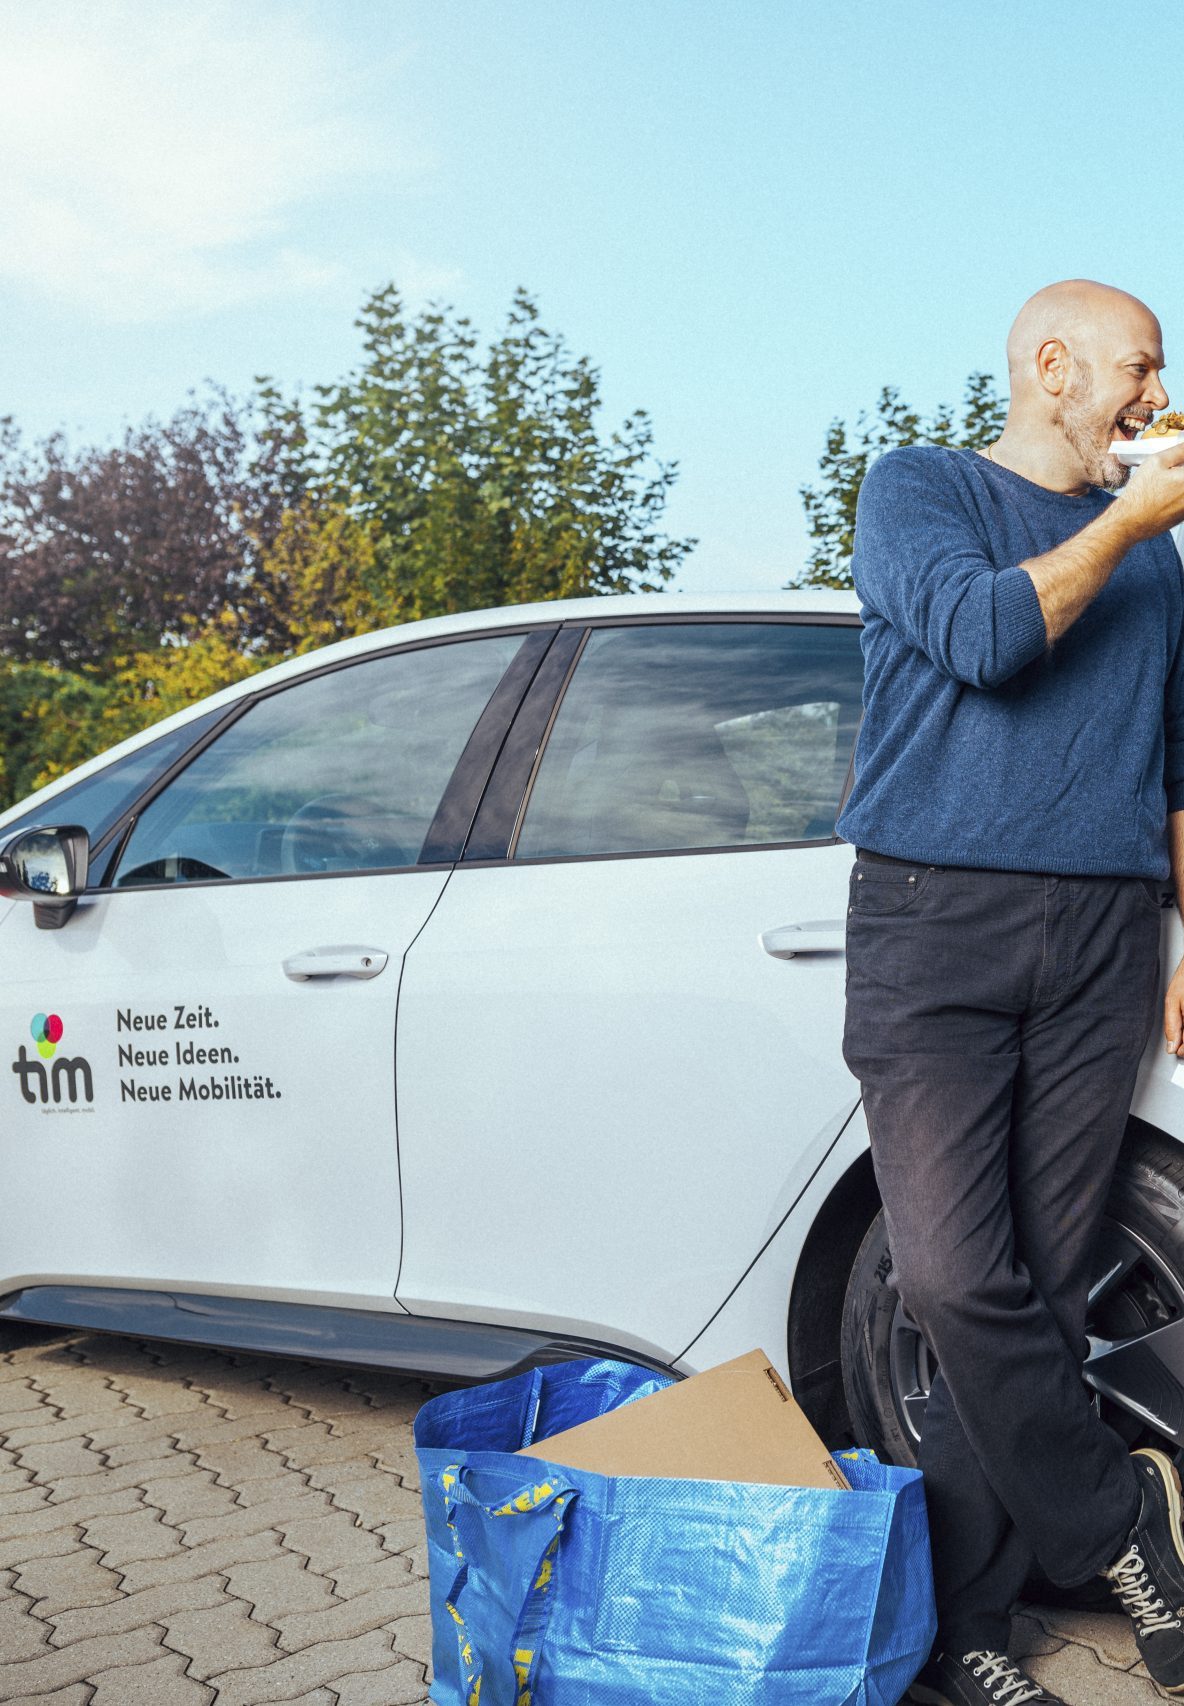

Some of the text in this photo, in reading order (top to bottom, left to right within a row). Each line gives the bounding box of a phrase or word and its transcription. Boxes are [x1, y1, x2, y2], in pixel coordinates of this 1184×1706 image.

[117, 1005, 219, 1032] Neue Zeit.
[118, 1041, 240, 1067] Neue Ideen.
[12, 1045, 94, 1104] tim
[120, 1075, 282, 1102] Neue Mobilität.
